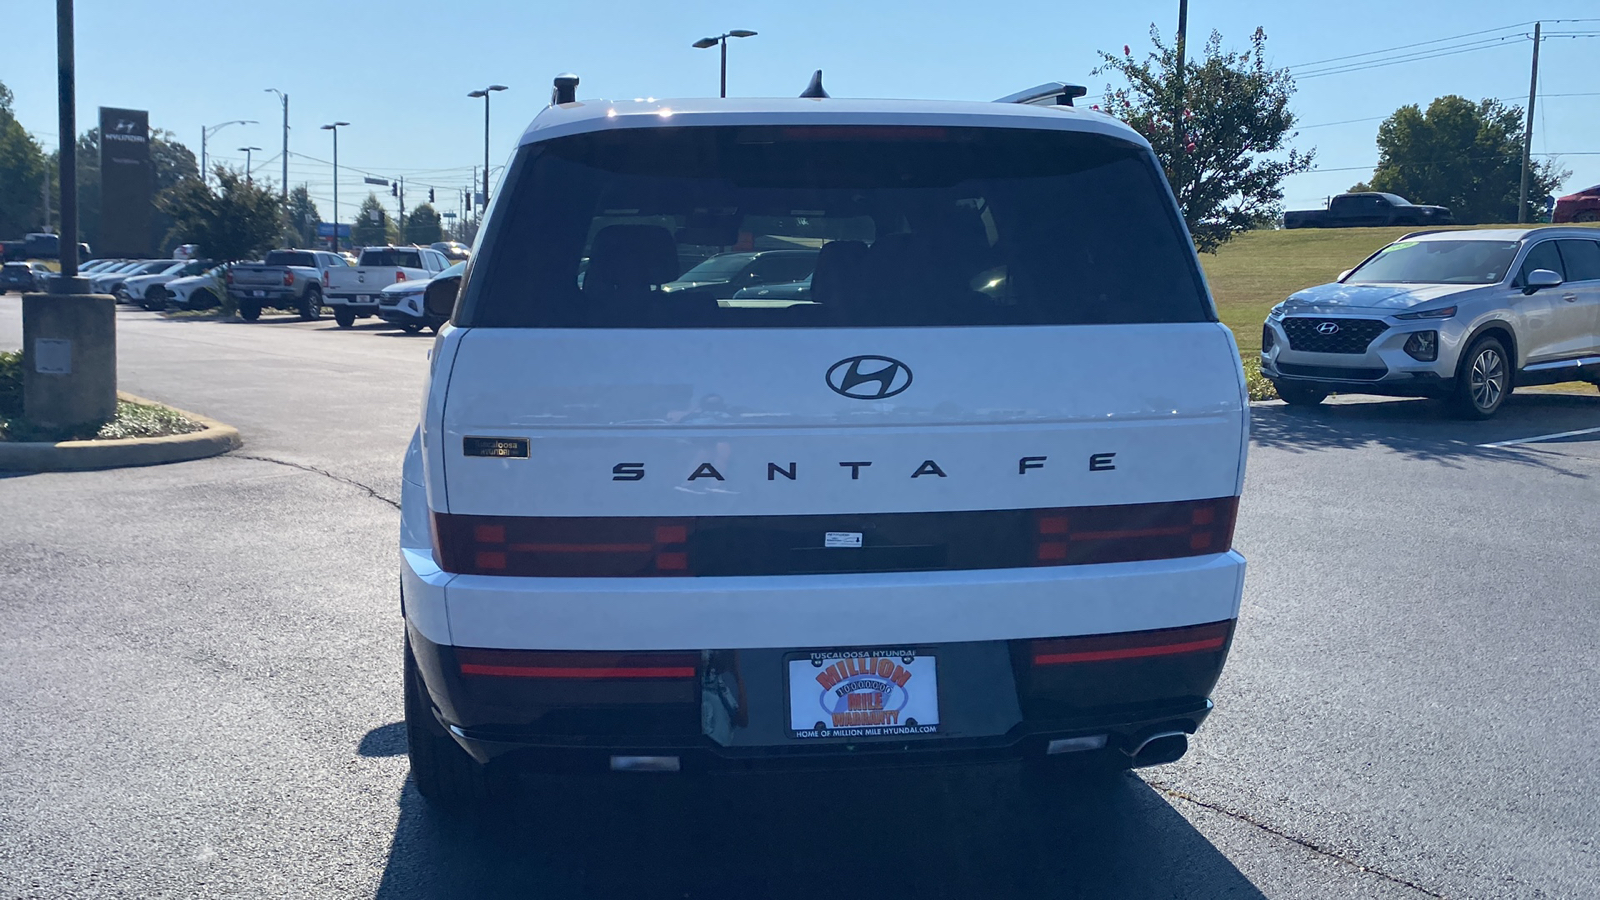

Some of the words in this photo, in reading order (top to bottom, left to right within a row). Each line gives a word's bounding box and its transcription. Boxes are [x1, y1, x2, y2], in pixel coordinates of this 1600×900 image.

[612, 460, 948, 481] SANTA
[1018, 452, 1117, 475] FE
[810, 652, 870, 660] TUSCALOOSA
[815, 657, 912, 691] MILLION
[848, 693, 883, 711] MILE
[832, 710, 899, 727] WARRANTY
[883, 726, 937, 734] HYUNDAI.COM
